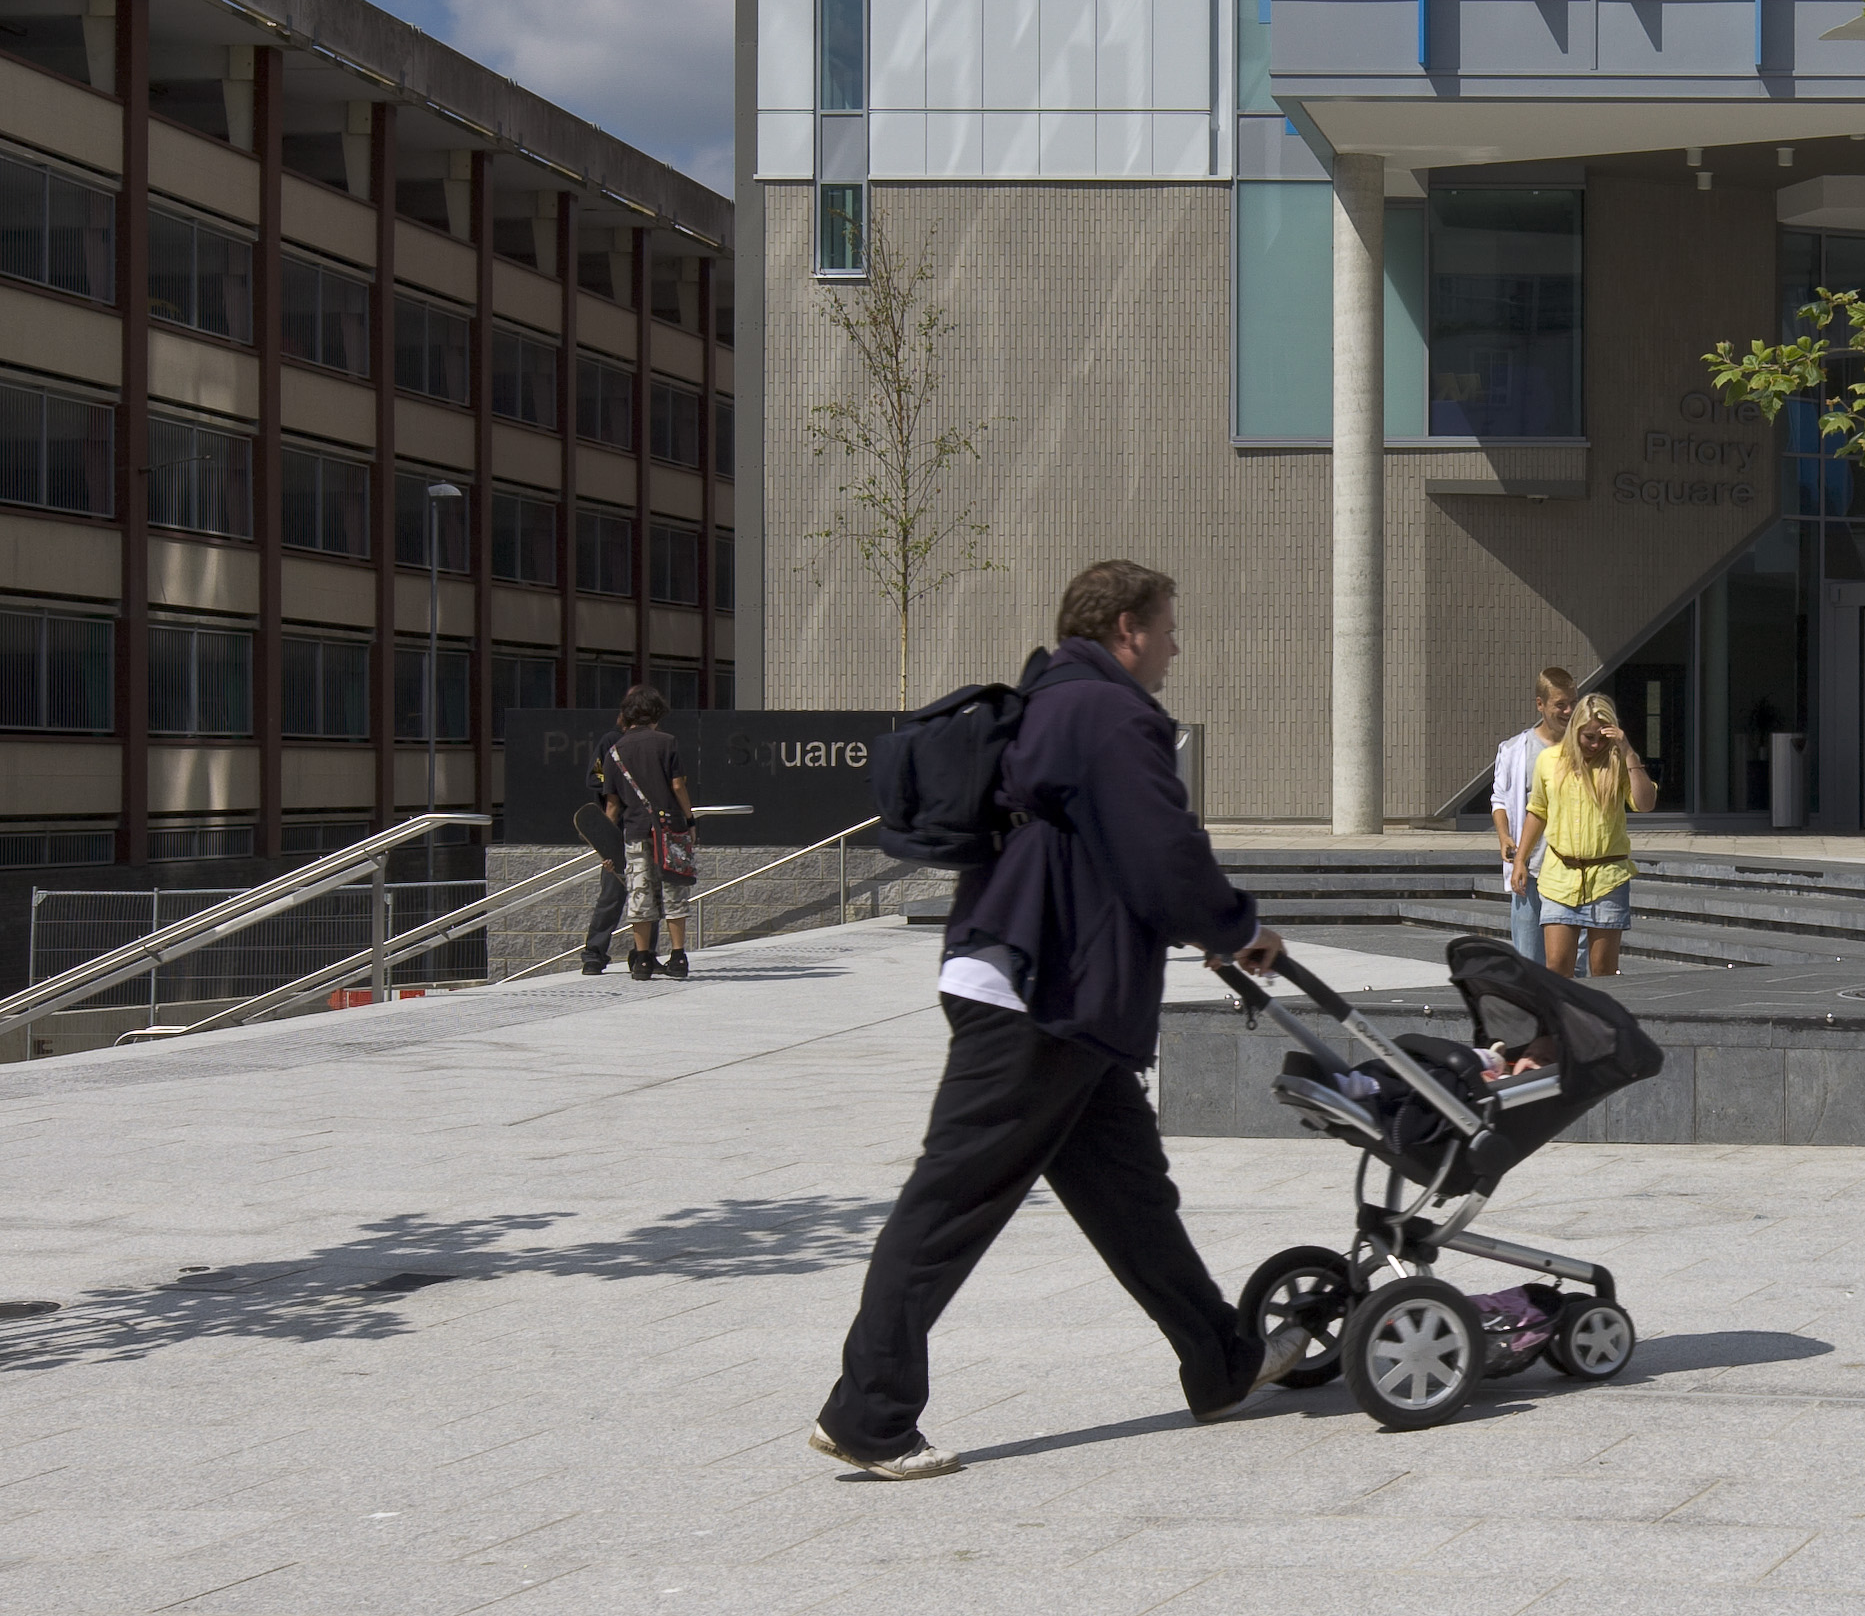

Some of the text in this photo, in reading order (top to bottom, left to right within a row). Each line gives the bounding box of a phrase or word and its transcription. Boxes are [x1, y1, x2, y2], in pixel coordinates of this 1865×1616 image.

[1680, 392, 1762, 424] One
[1645, 431, 1758, 473] Priory
[1614, 471, 1755, 512] Square
[543, 731, 868, 776] Pri Square
